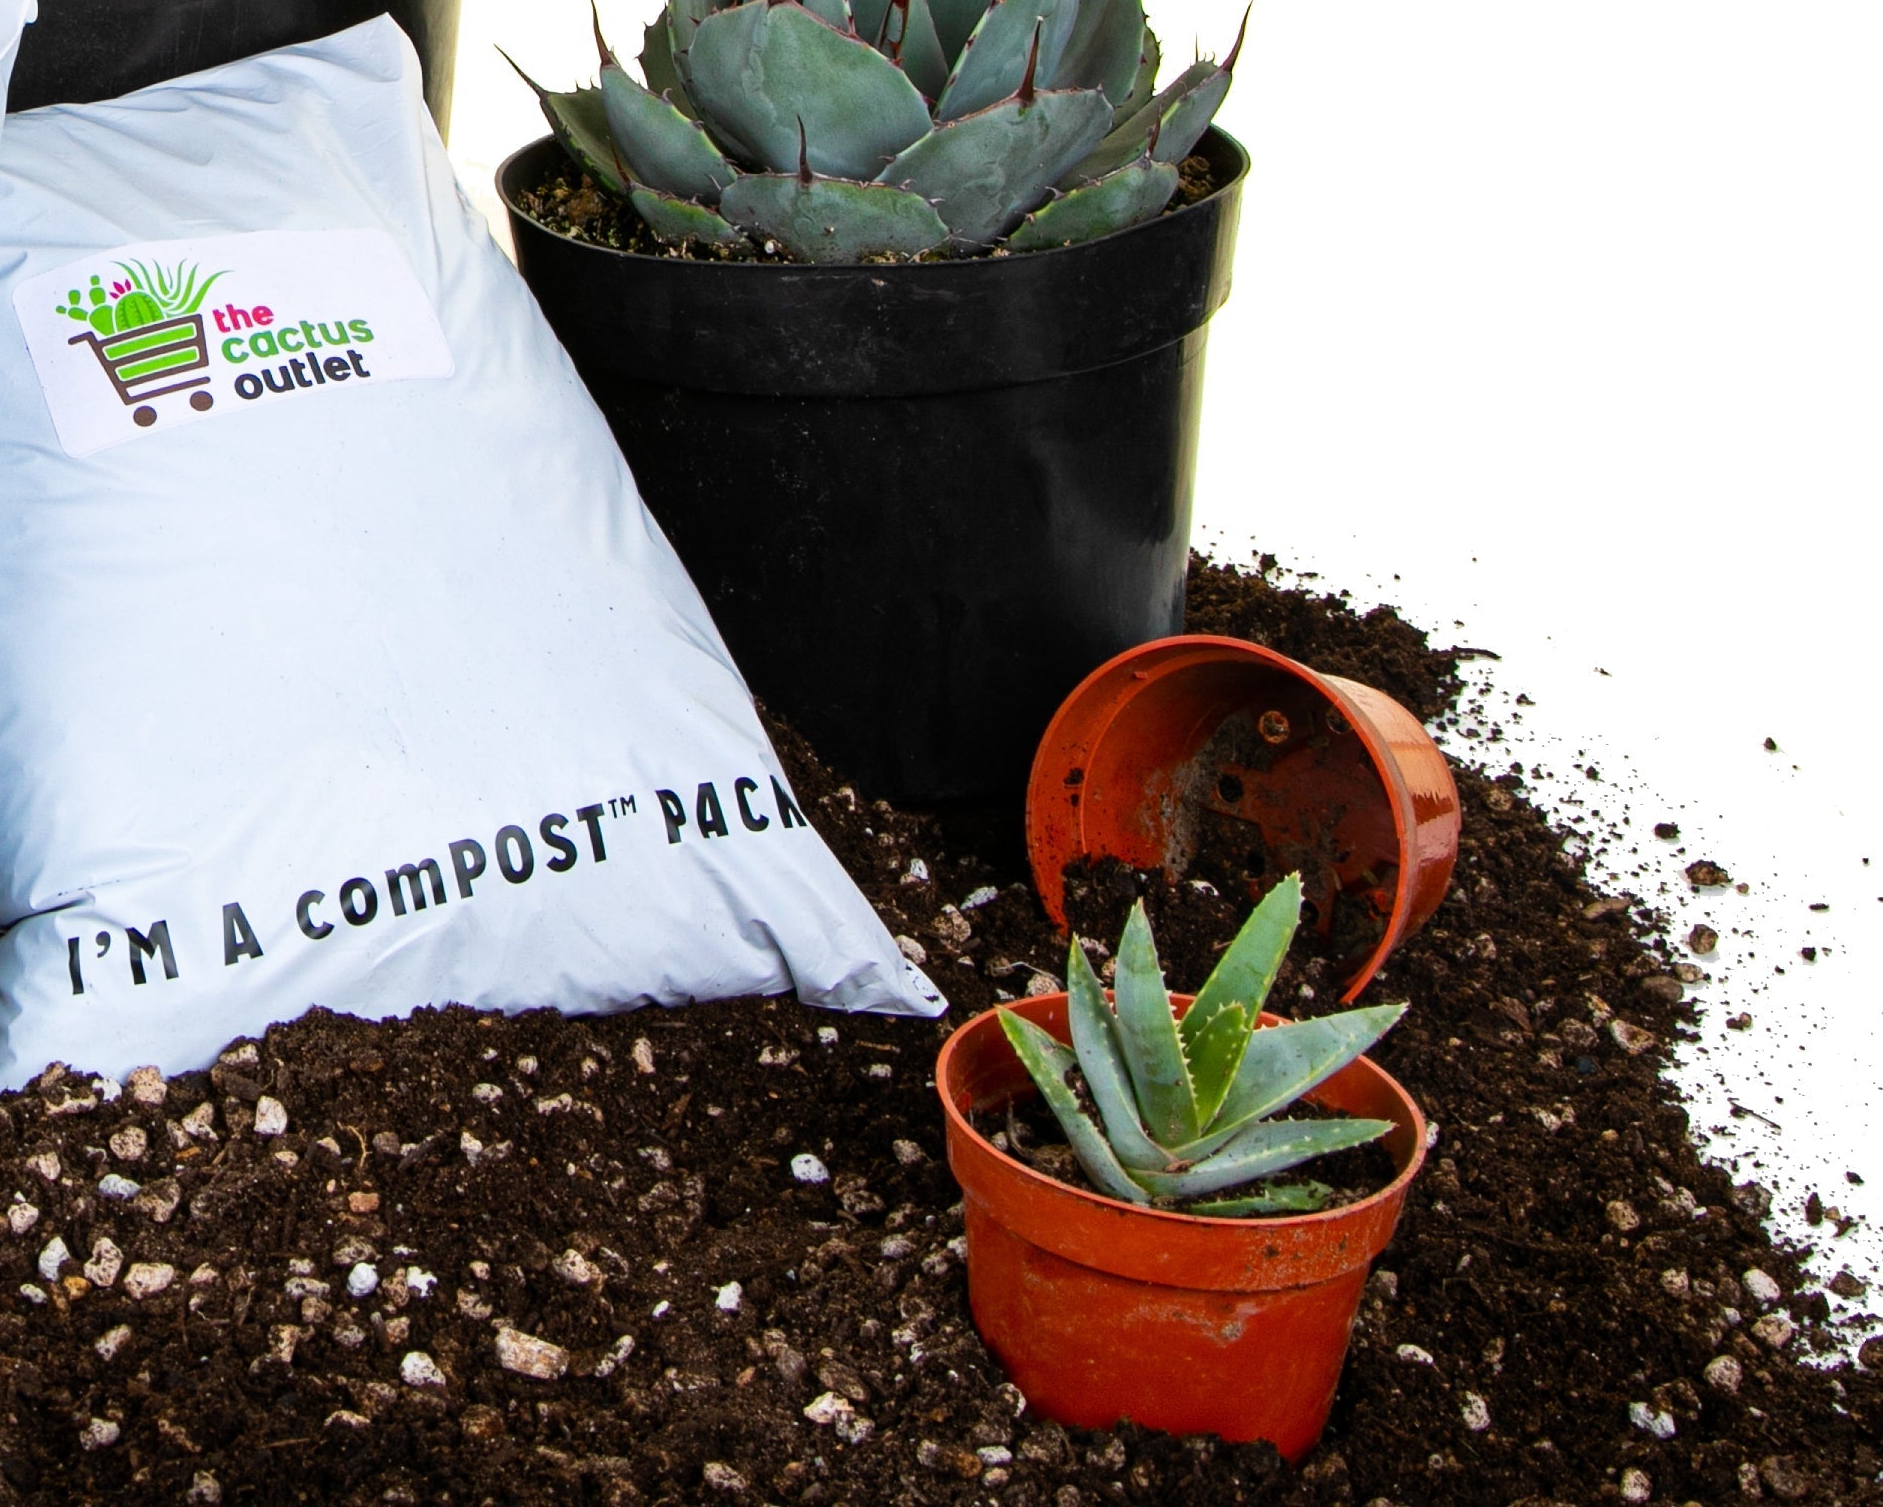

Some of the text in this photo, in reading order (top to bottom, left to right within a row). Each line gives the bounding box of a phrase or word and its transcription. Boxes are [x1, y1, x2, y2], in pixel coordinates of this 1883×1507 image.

[212, 303, 274, 334] the
[221, 318, 375, 364] cactus
[234, 349, 371, 400] outlet
[222, 902, 265, 966] A
